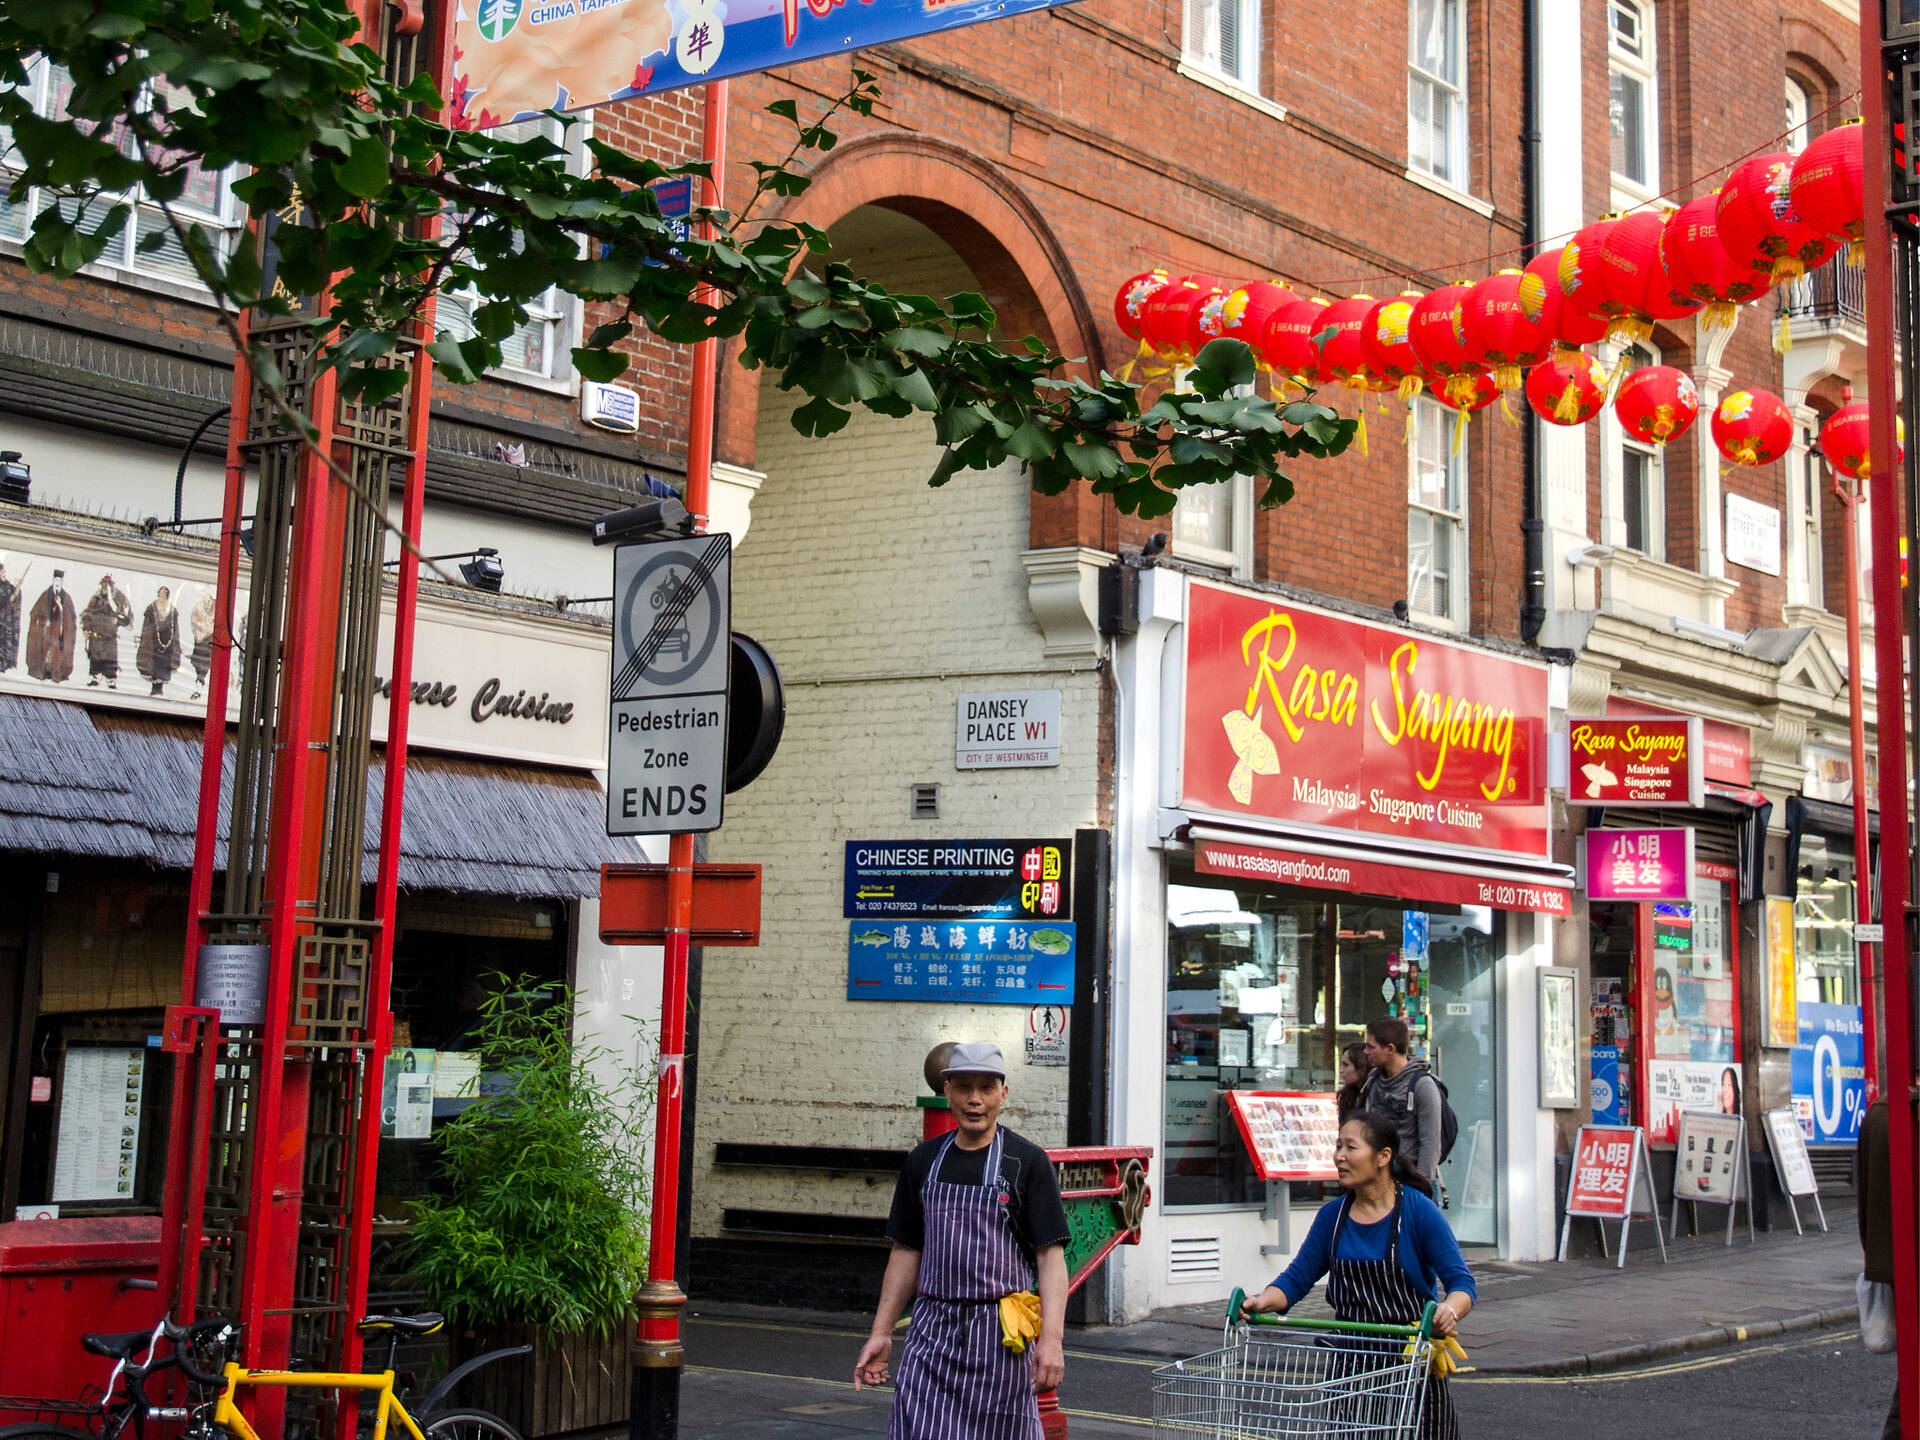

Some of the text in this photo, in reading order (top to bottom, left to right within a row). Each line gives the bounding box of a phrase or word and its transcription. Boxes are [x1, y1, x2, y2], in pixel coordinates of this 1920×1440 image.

[531, 5, 575, 24] CHINA
[471, 677, 574, 724] Cuisine
[967, 698, 1029, 720] DANSEY
[1241, 609, 1515, 802] Rasa Sayang
[618, 708, 719, 733] Pedestrian
[967, 721, 1047, 742] PLACE W1
[1571, 724, 1616, 755] Rasa
[1619, 724, 1686, 762] Sayang
[643, 748, 689, 769] Zone
[966, 752, 1049, 763] CITY OF WESTMINSTER
[1626, 764, 1670, 776] Malaysia
[1624, 777, 1672, 789] Singapore
[622, 783, 708, 818] ENDS
[1292, 776, 1358, 813] Malaysia
[1369, 789, 1435, 823] Singapore
[1436, 806, 1483, 830] Cuisine
[1629, 789, 1666, 800] Cuisine
[855, 848, 1014, 866] CHINESE PRINTING
[1612, 834, 1661, 859] 小明
[1205, 849, 1350, 884] www.rasasayangfood.com
[1612, 860, 1662, 886] 美发
[855, 902, 867, 910] Tel:
[868, 902, 882, 910] 020
[883, 902, 917, 911] 74379523
[1477, 883, 1563, 910] Tel: 020 7734 1382
[1450, 1004, 1467, 1014] OPEN
[1825, 1019, 1835, 1032] We
[1836, 1020, 1848, 1035] Buy
[1028, 1053, 1066, 1061] Pedestrians
[1035, 1043, 1059, 1052] Caution
[1582, 1140, 1630, 1168] 小明
[1577, 1167, 1627, 1194] 理发
